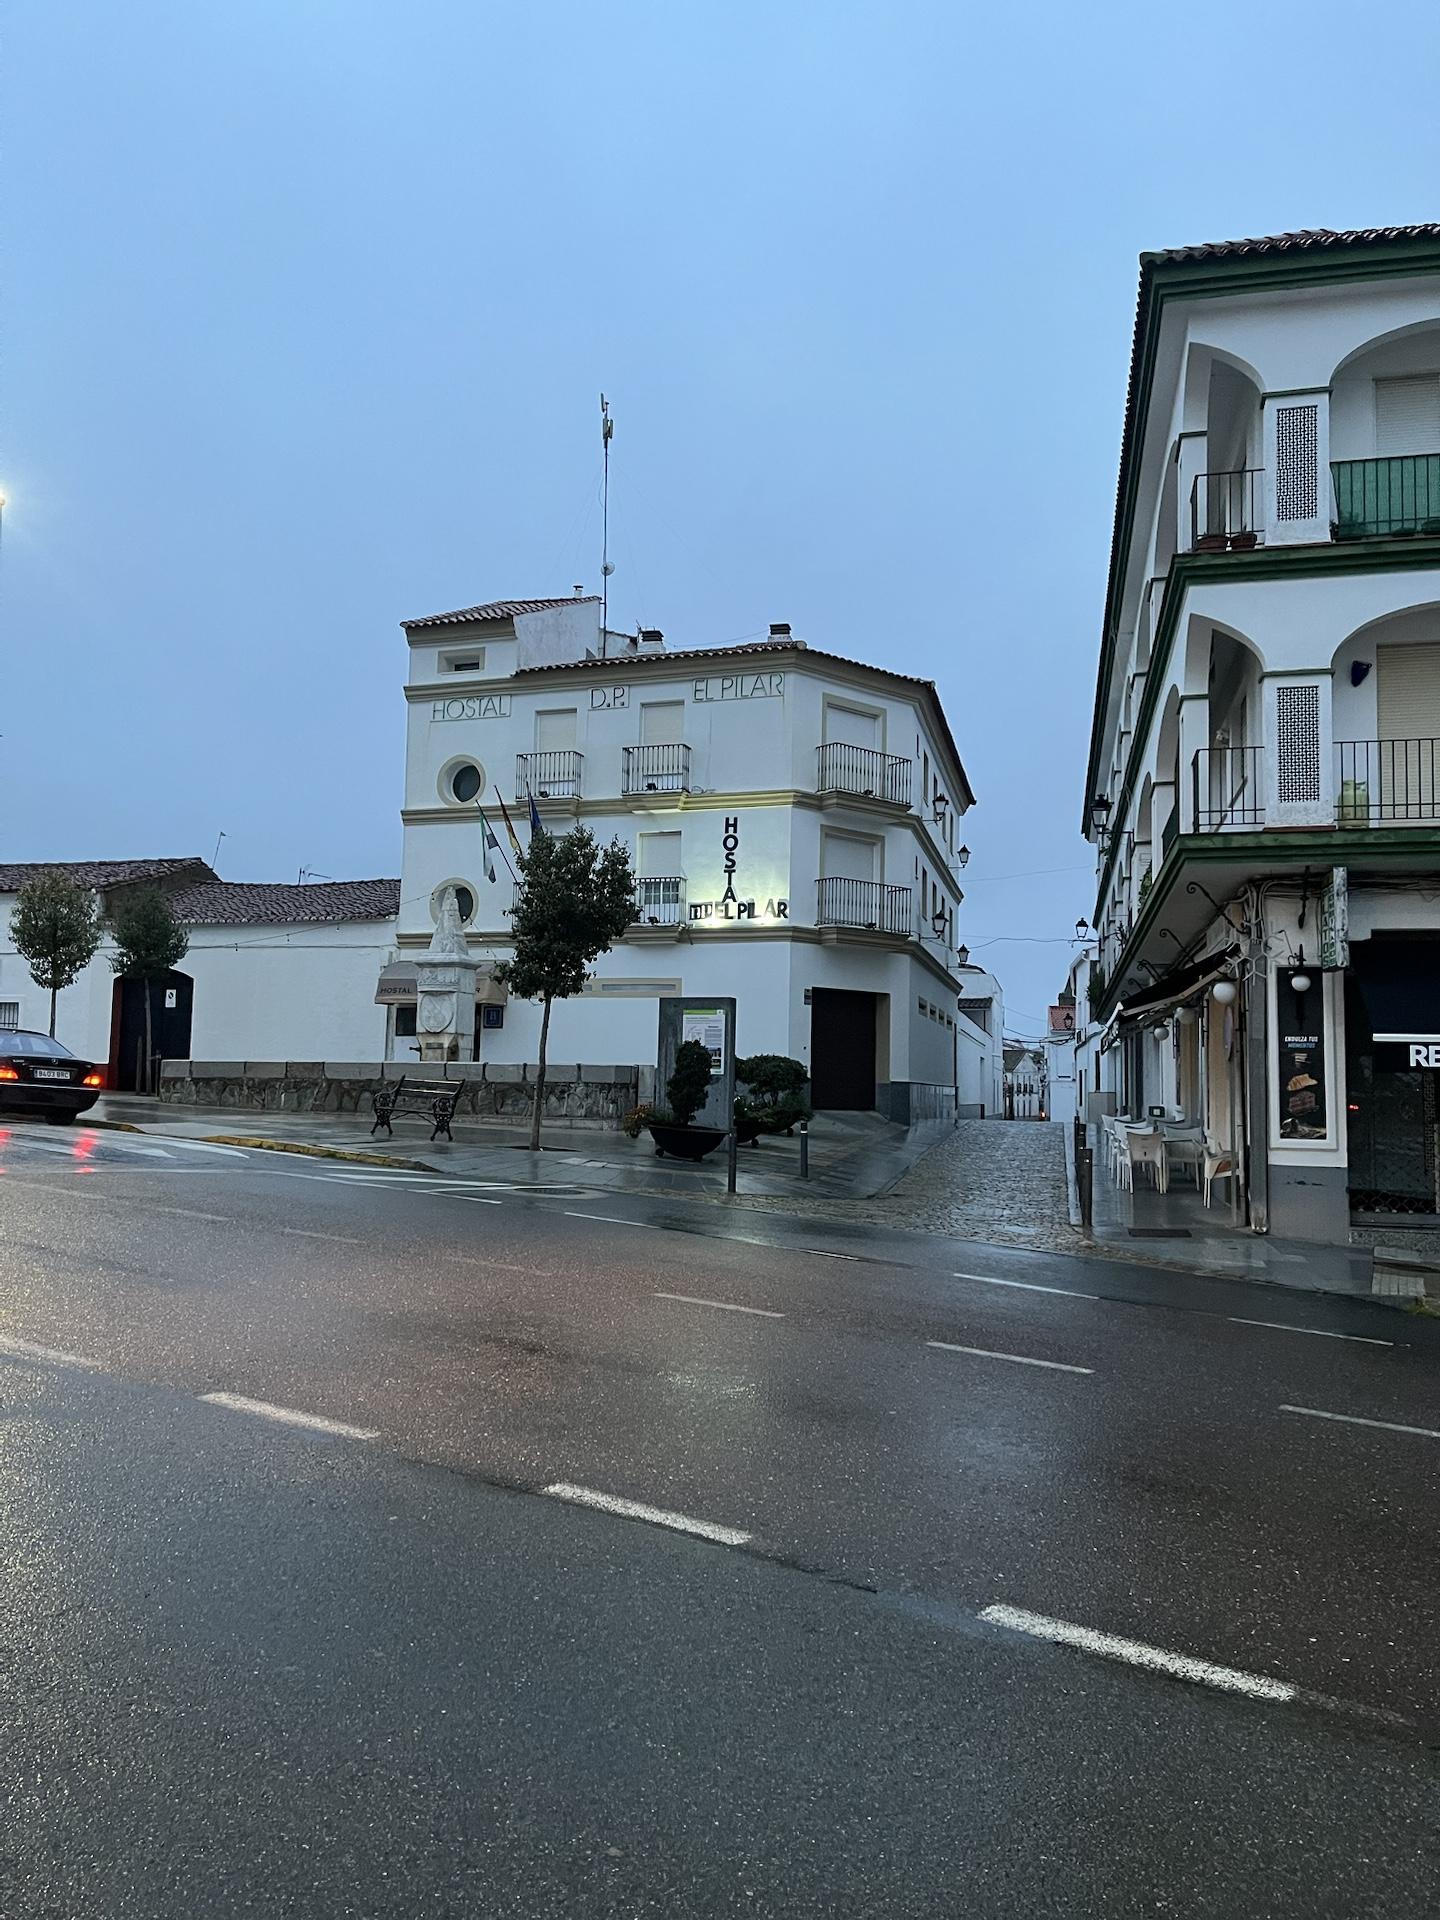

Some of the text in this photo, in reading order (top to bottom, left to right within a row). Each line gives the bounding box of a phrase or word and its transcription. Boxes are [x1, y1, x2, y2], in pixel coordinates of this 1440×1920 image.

[432, 695, 508, 721] HOSTAL
[693, 678, 715, 701] EL
[720, 673, 783, 699] PILAR
[379, 986, 412, 994] HOSTAL
